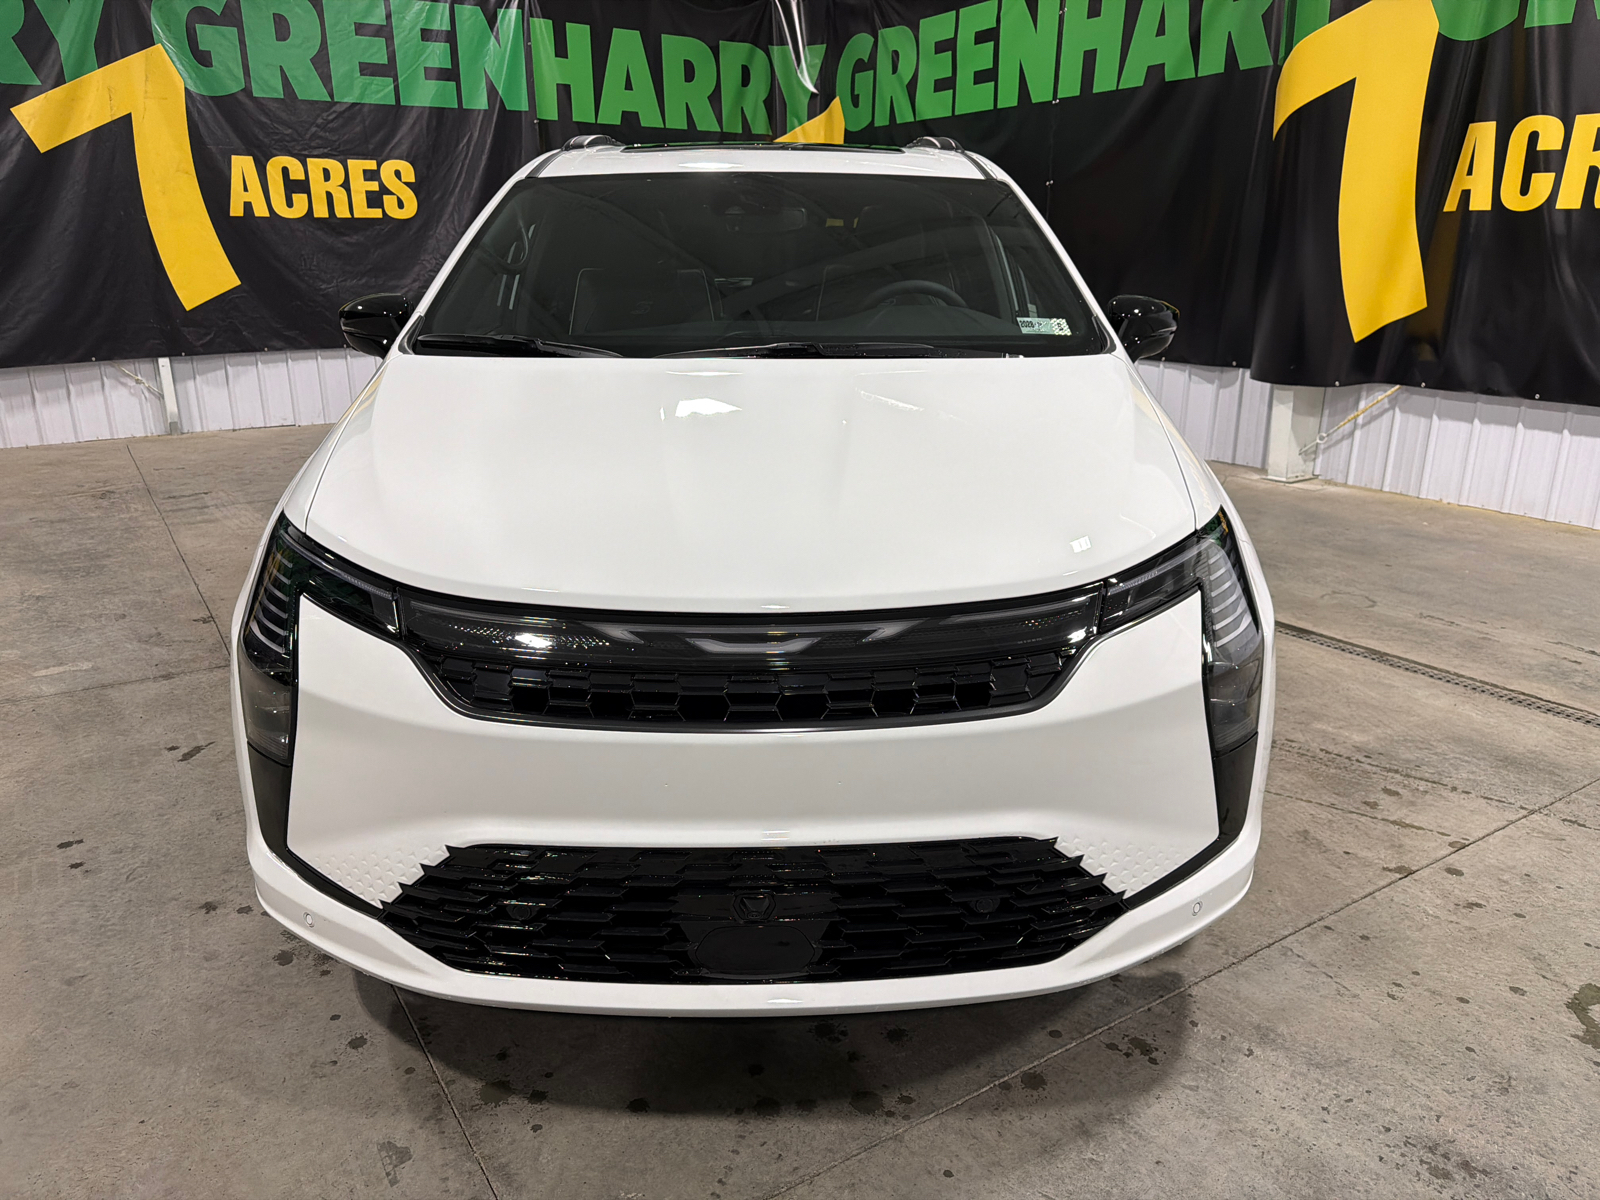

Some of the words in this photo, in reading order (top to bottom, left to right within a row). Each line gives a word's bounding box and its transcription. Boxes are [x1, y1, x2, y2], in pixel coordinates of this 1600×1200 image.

[150, 0, 530, 112] GREEN
[529, 16, 827, 136] HARRY
[835, 0, 1061, 132] GREEN
[10, 43, 242, 312] 7
[229, 154, 419, 220] ACRES
[1273, 0, 1441, 343] 7
